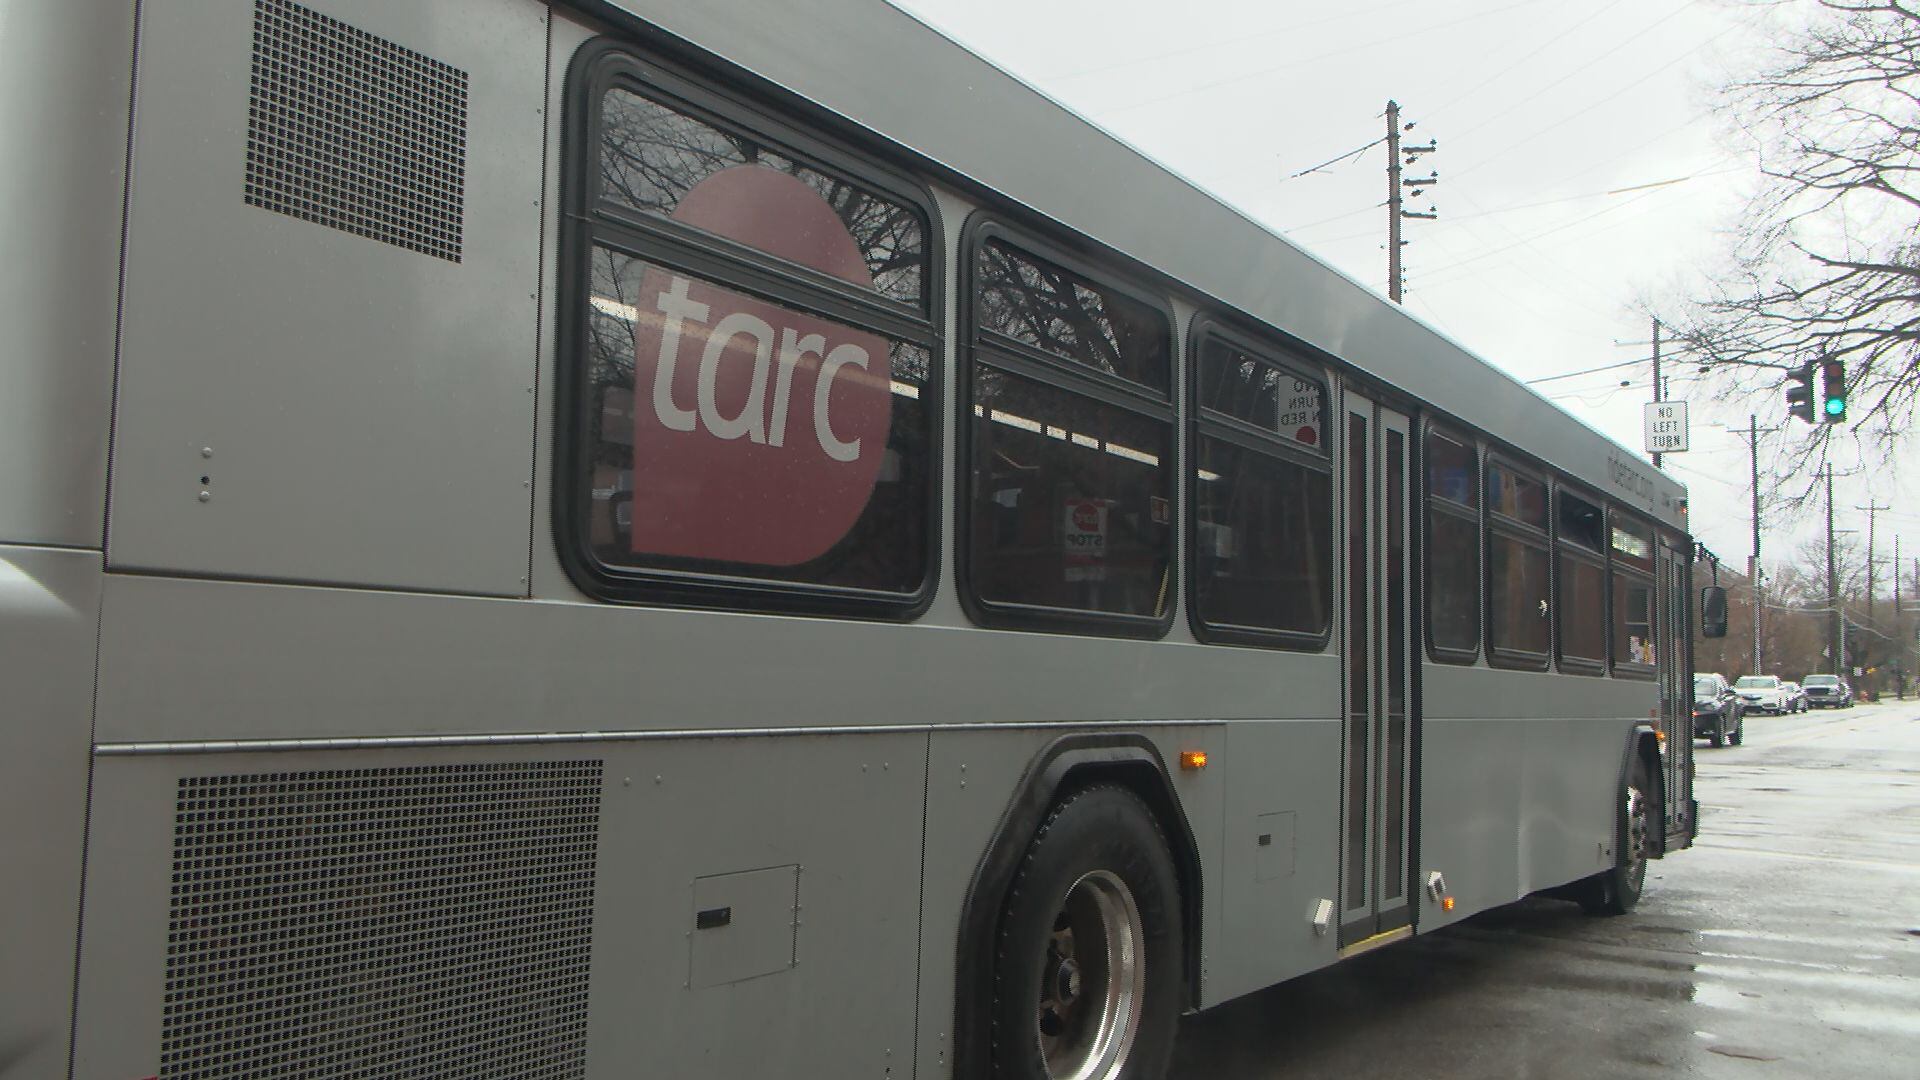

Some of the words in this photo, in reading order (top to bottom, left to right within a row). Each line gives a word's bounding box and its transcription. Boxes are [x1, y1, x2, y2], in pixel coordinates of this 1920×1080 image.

[653, 276, 870, 462] tarc
[1658, 407, 1672, 418] NO
[1653, 420, 1677, 432] LEFT
[1652, 435, 1680, 447] TURN
